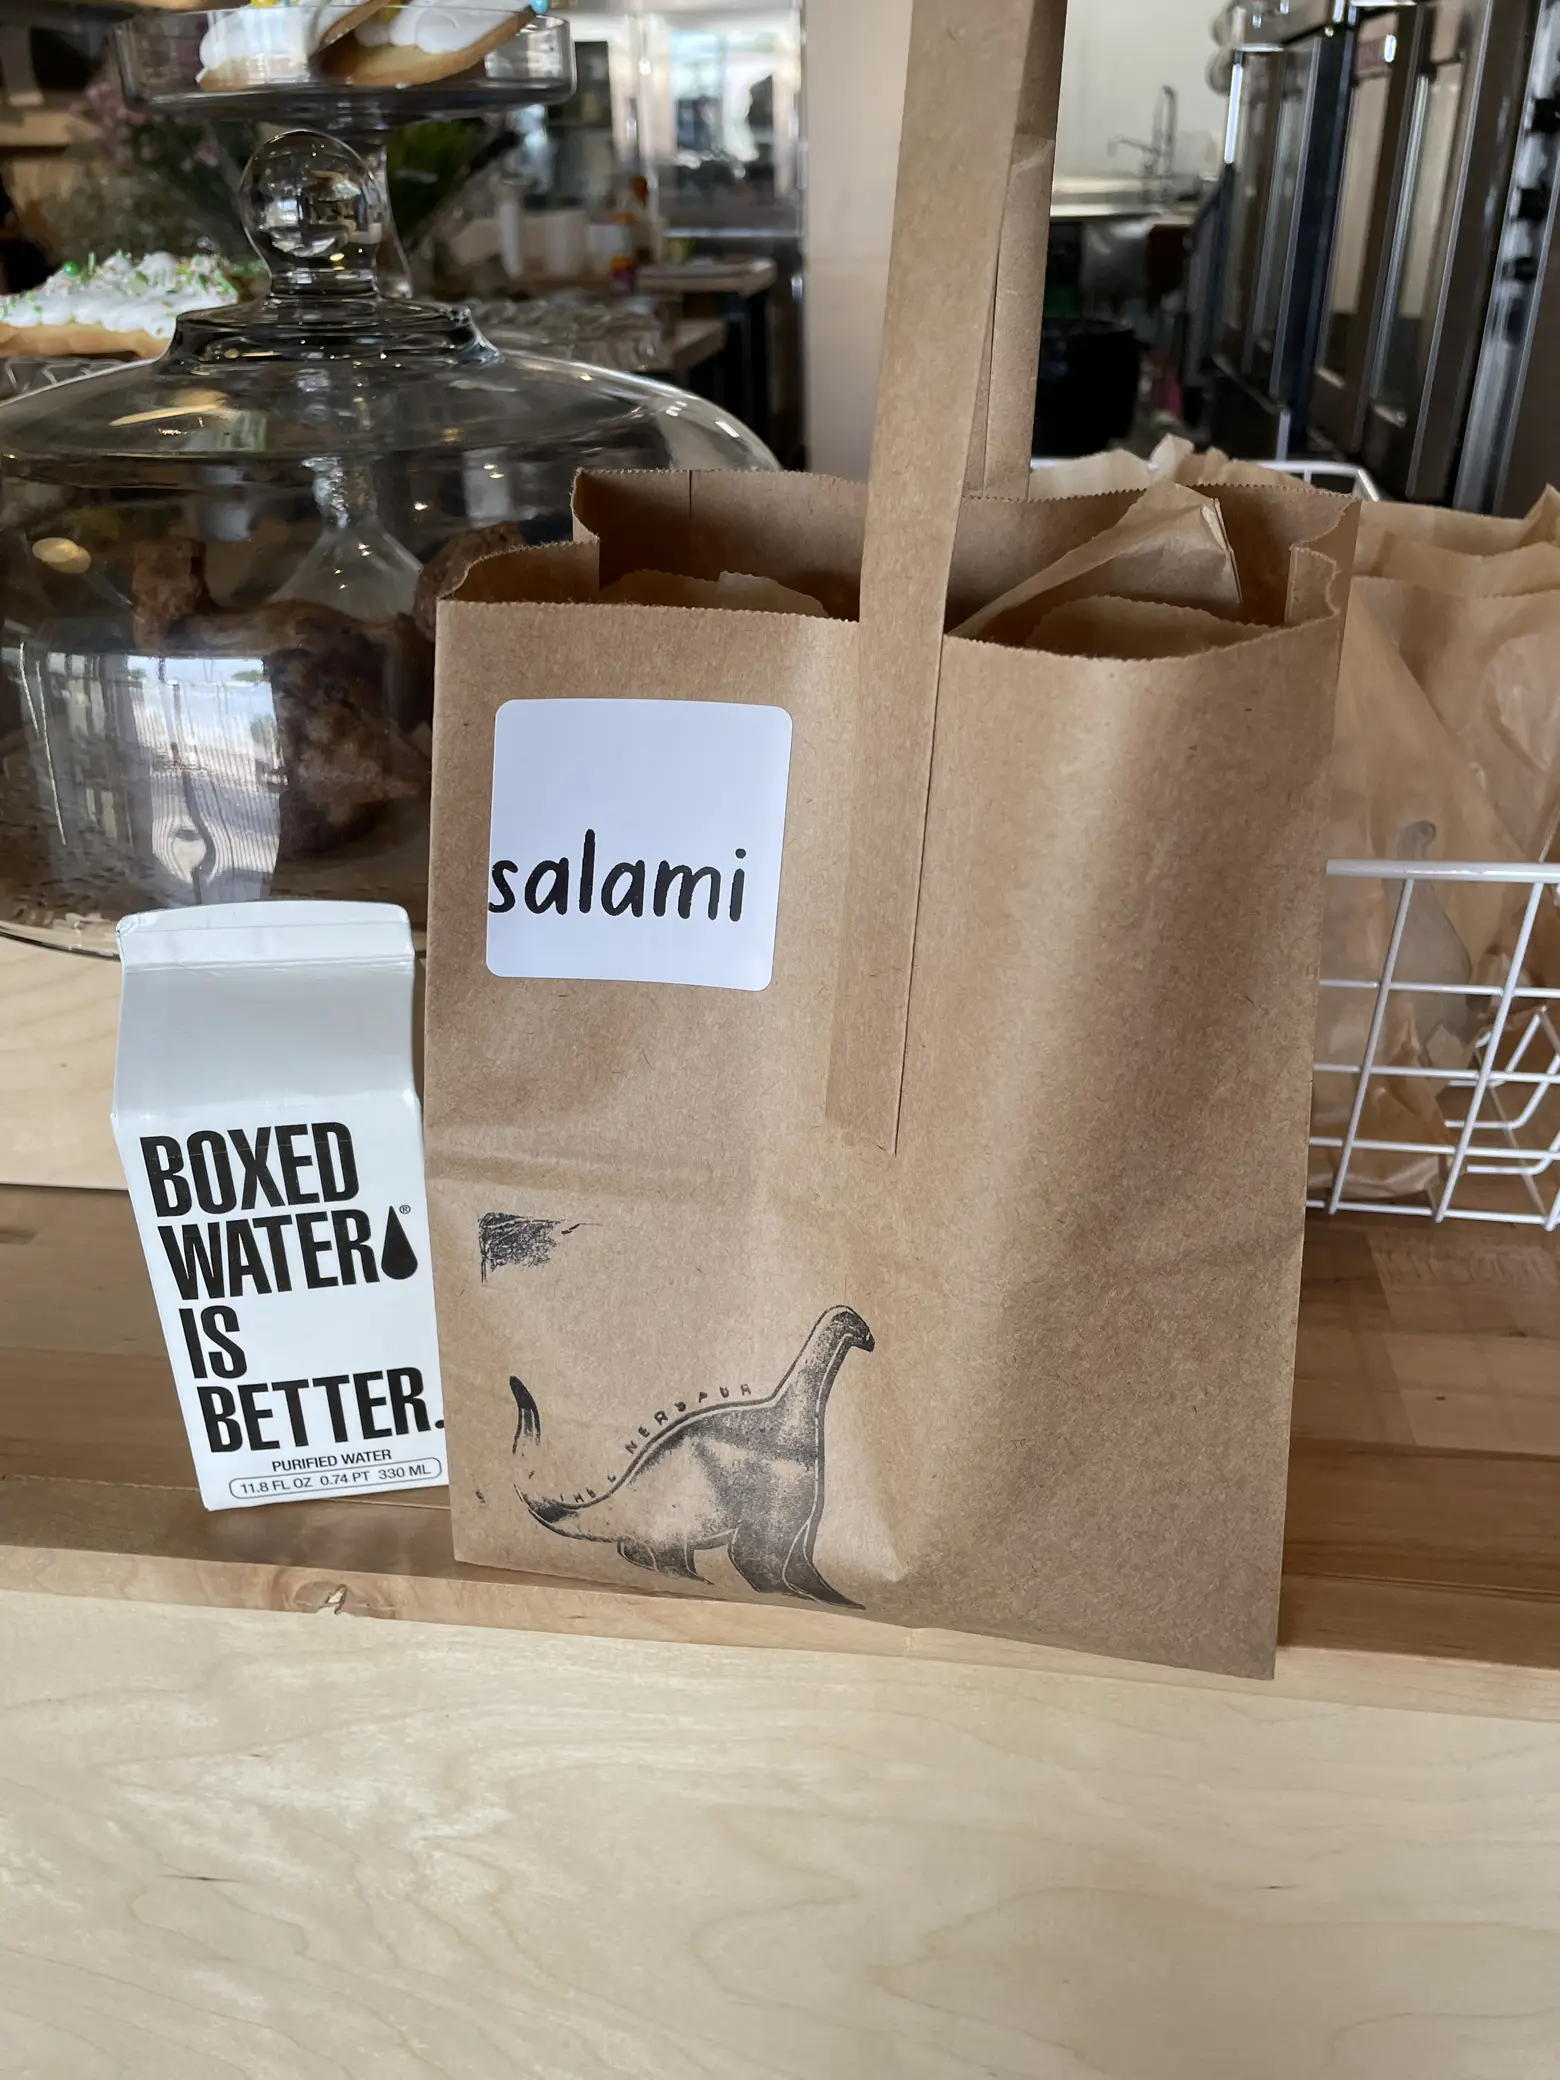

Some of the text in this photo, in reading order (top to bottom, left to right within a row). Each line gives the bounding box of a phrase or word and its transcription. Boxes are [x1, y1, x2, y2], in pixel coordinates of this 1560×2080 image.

[488, 828, 747, 922] salami
[139, 1121, 360, 1218] BOXED
[157, 1208, 380, 1301] WATER
[178, 1304, 248, 1379] IS
[240, 1463, 432, 1494] 11.8 FL OZ 0.74 PT 330 ML
[271, 1449, 393, 1472] PURIFIED WATER
